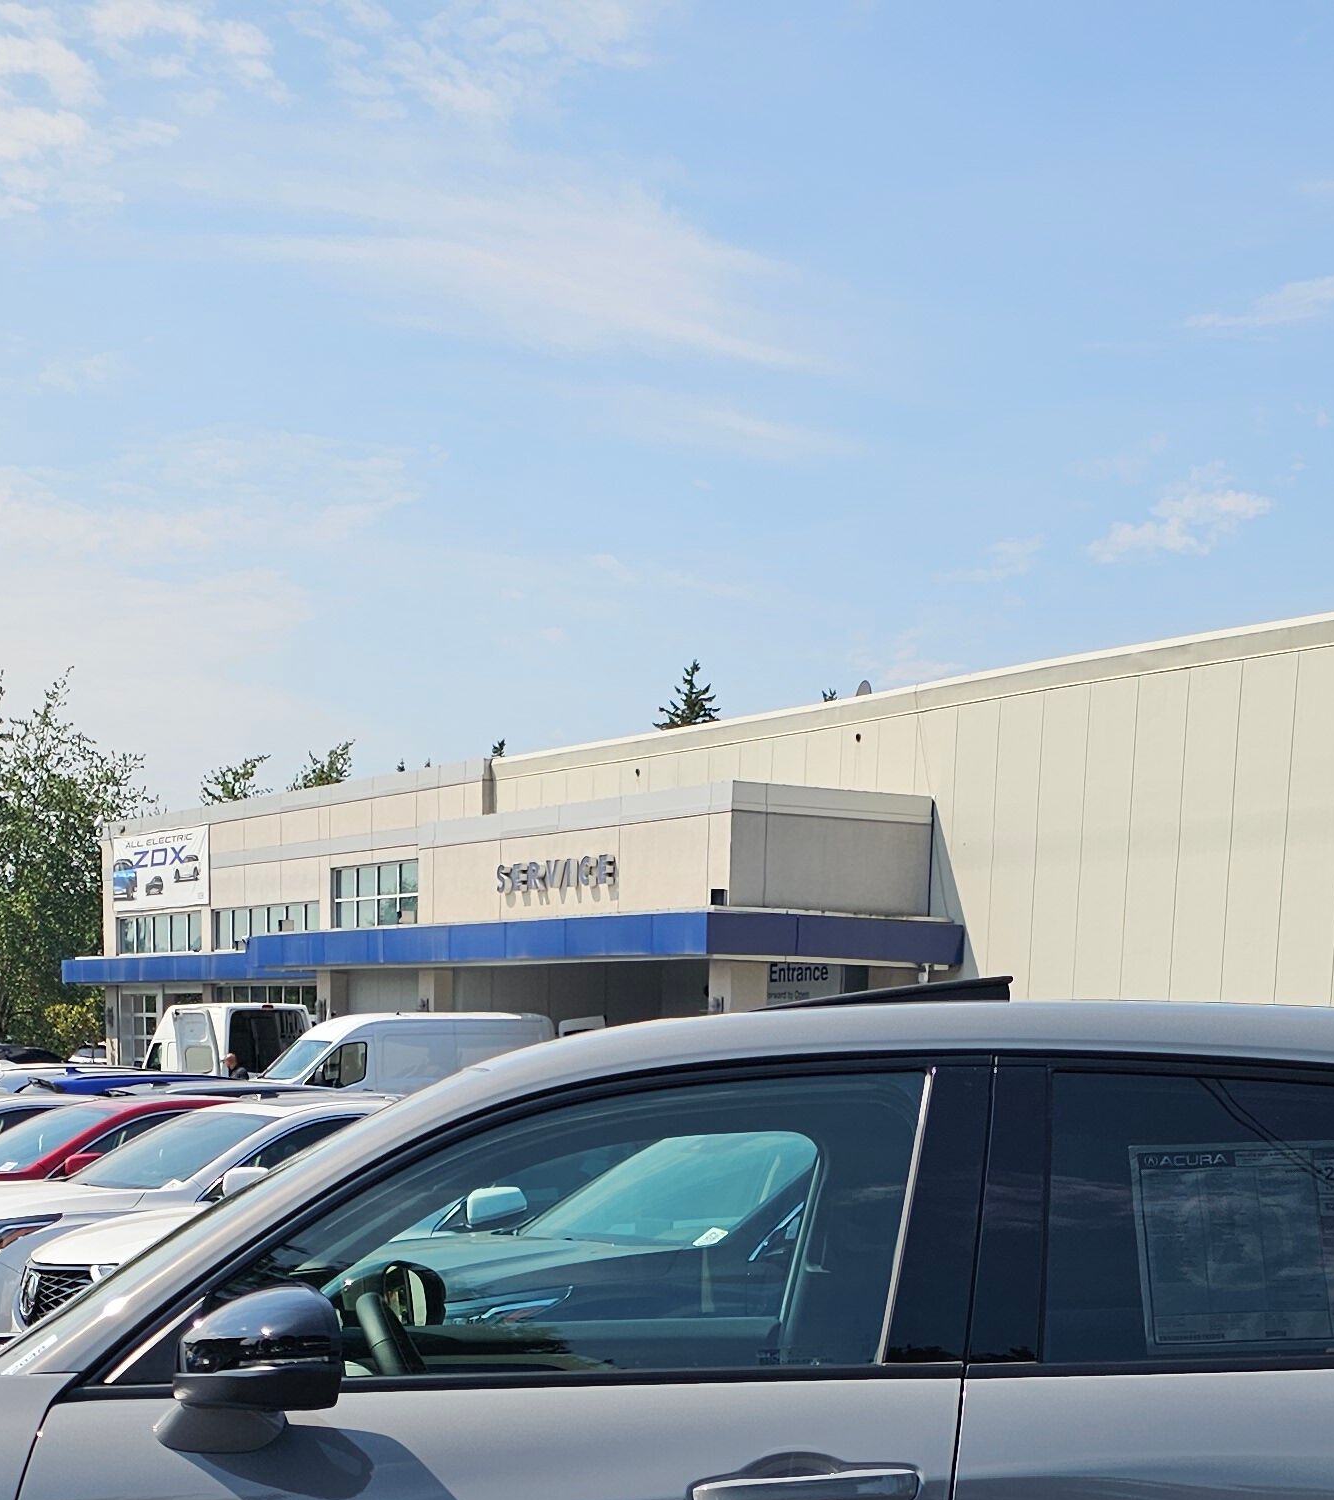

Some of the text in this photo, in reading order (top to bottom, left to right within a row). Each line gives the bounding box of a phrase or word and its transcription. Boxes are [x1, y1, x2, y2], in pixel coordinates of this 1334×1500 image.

[146, 833, 193, 846] ELECTRIC
[132, 845, 187, 869] ZDX
[497, 854, 616, 895] SERVICE
[769, 963, 829, 982] Entrance
[1159, 1153, 1228, 1167] ACURA
